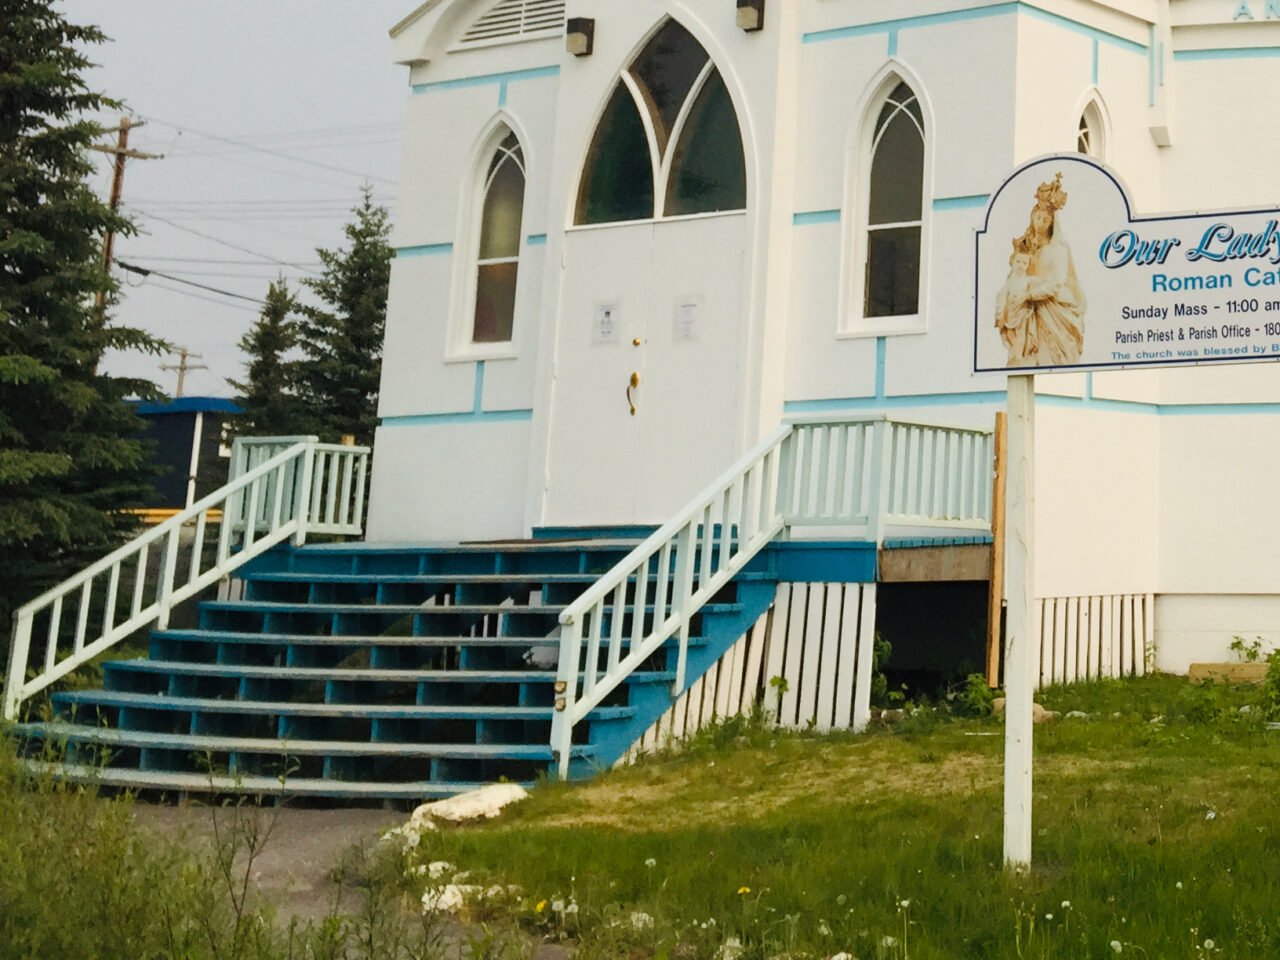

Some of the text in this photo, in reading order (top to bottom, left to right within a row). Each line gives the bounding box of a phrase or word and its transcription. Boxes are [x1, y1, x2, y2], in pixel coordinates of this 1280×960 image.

[1099, 229, 1181, 269] Our
[1152, 273, 1233, 292] Roman
[1121, 306, 1169, 320] Sunday
[1174, 303, 1208, 317] Mass
[1226, 299, 1259, 314] 11:00
[1115, 330, 1144, 344] Parish
[1147, 328, 1174, 342] Priest
[1178, 327, 1185, 341] &
[1189, 326, 1218, 340] Parish
[1221, 324, 1251, 338] Office
[1111, 350, 1131, 360] The
[1136, 348, 1173, 359] church
[1177, 348, 1199, 357] was
[1203, 345, 1249, 357] blessed
[1252, 345, 1267, 355] by
